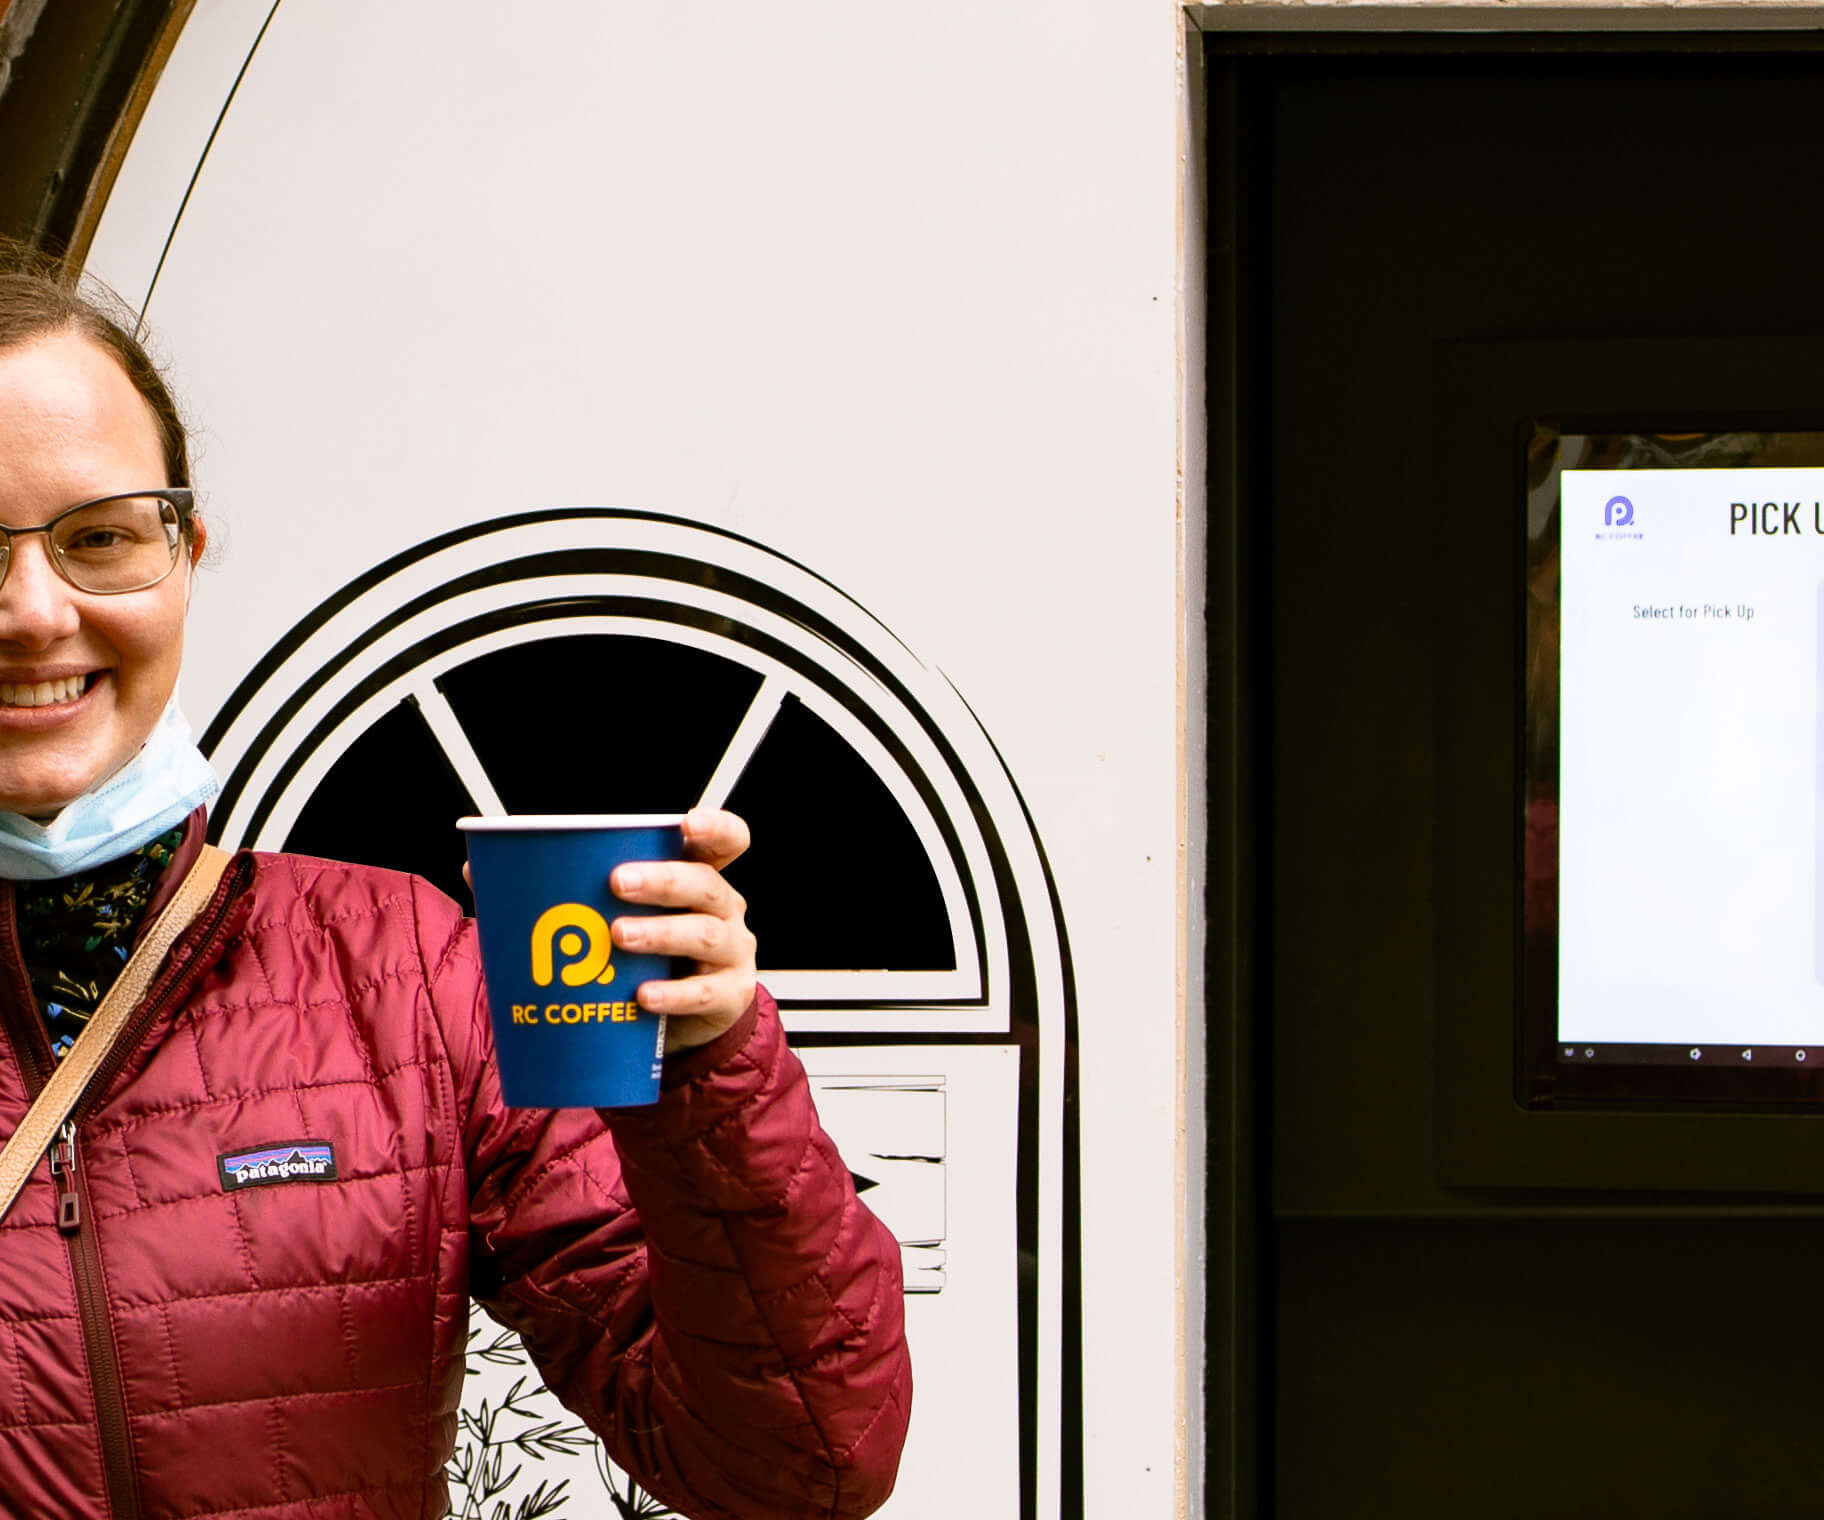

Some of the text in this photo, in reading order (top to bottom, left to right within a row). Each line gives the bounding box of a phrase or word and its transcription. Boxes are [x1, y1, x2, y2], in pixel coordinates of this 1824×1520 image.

[1730, 501, 1801, 536] PICK
[1632, 604, 1755, 621] Select for Pick Up
[511, 1001, 639, 1025] RC COFFEE
[235, 1160, 327, 1184] patagonia
